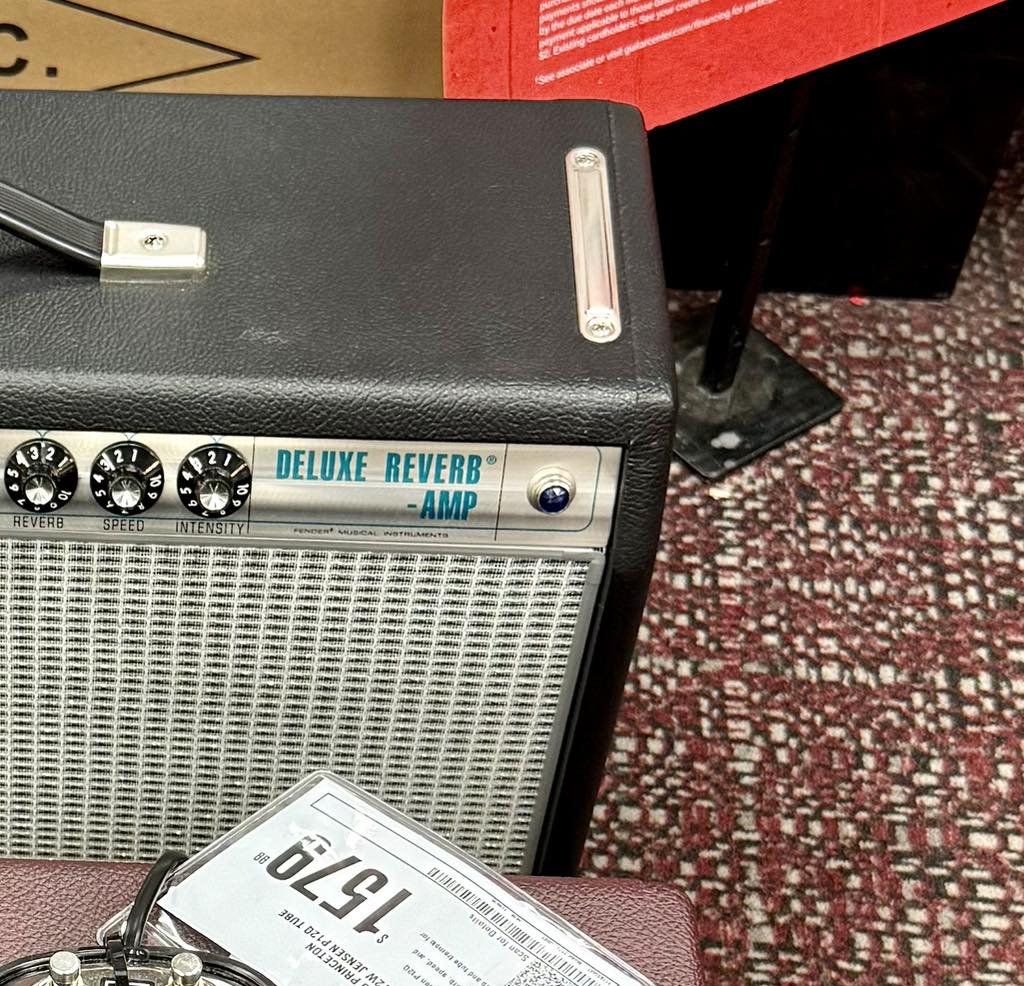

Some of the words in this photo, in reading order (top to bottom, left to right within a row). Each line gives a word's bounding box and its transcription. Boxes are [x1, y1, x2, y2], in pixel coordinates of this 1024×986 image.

[276, 449, 369, 482] DELUXE
[13, 515, 64, 529] REVERB
[103, 519, 145, 532] SPEED
[176, 521, 244, 534] INTENSITY
[265, 834, 412, 929] 1579
[277, 908, 305, 928] TUBE
[466, 913, 497, 937] Details
[375, 933, 389, 944] $
[494, 934, 510, 946] for
[328, 943, 368, 974] JENSEN
[506, 943, 530, 961] Scan
[304, 941, 361, 985] PRINCETON
